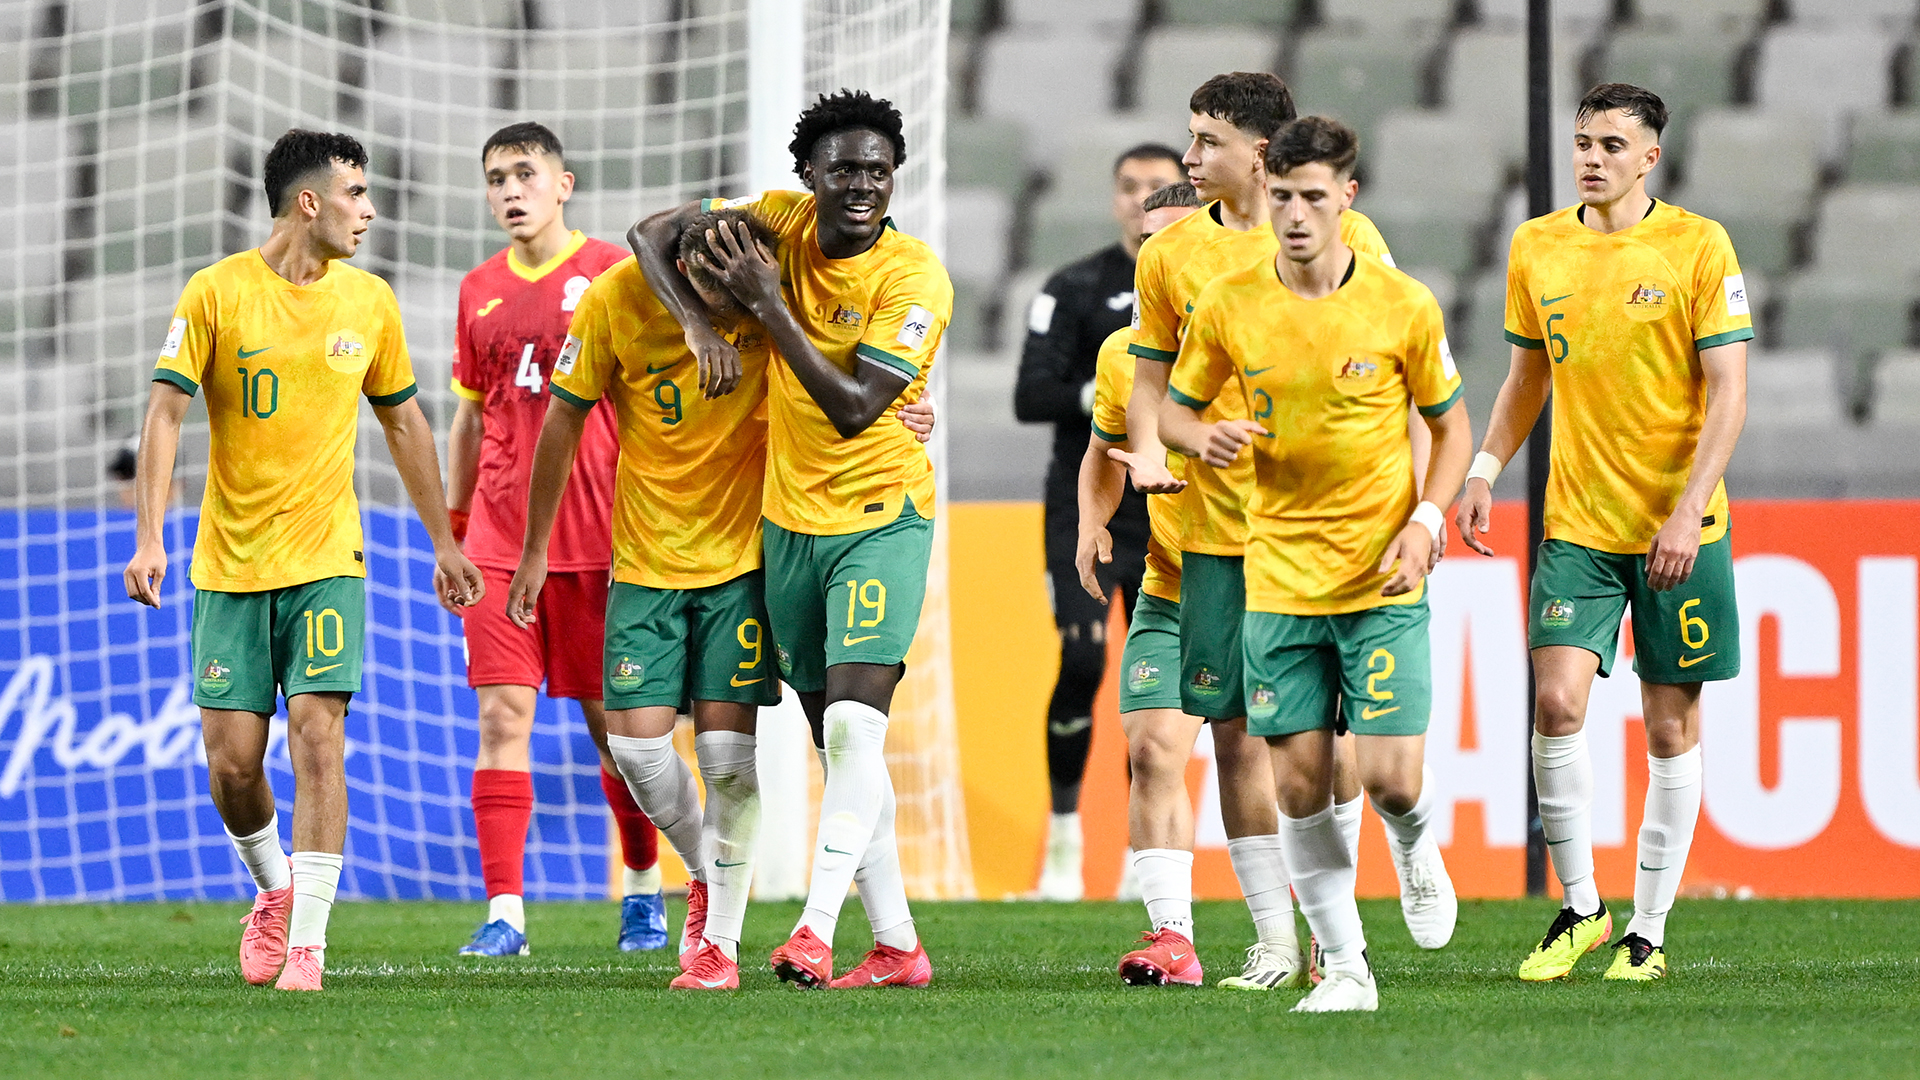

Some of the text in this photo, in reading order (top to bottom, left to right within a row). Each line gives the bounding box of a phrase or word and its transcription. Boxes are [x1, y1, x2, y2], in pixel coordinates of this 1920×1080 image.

[1546, 313, 1569, 364] 6
[237, 367, 279, 419] 10
[515, 343, 543, 393] 4
[654, 379, 682, 425] 9
[1253, 388, 1276, 438] 2
[846, 579, 887, 628] 19
[1678, 598, 1710, 649] 6
[304, 608, 344, 658] 10
[737, 618, 762, 669] 9
[1367, 648, 1395, 700] 2
